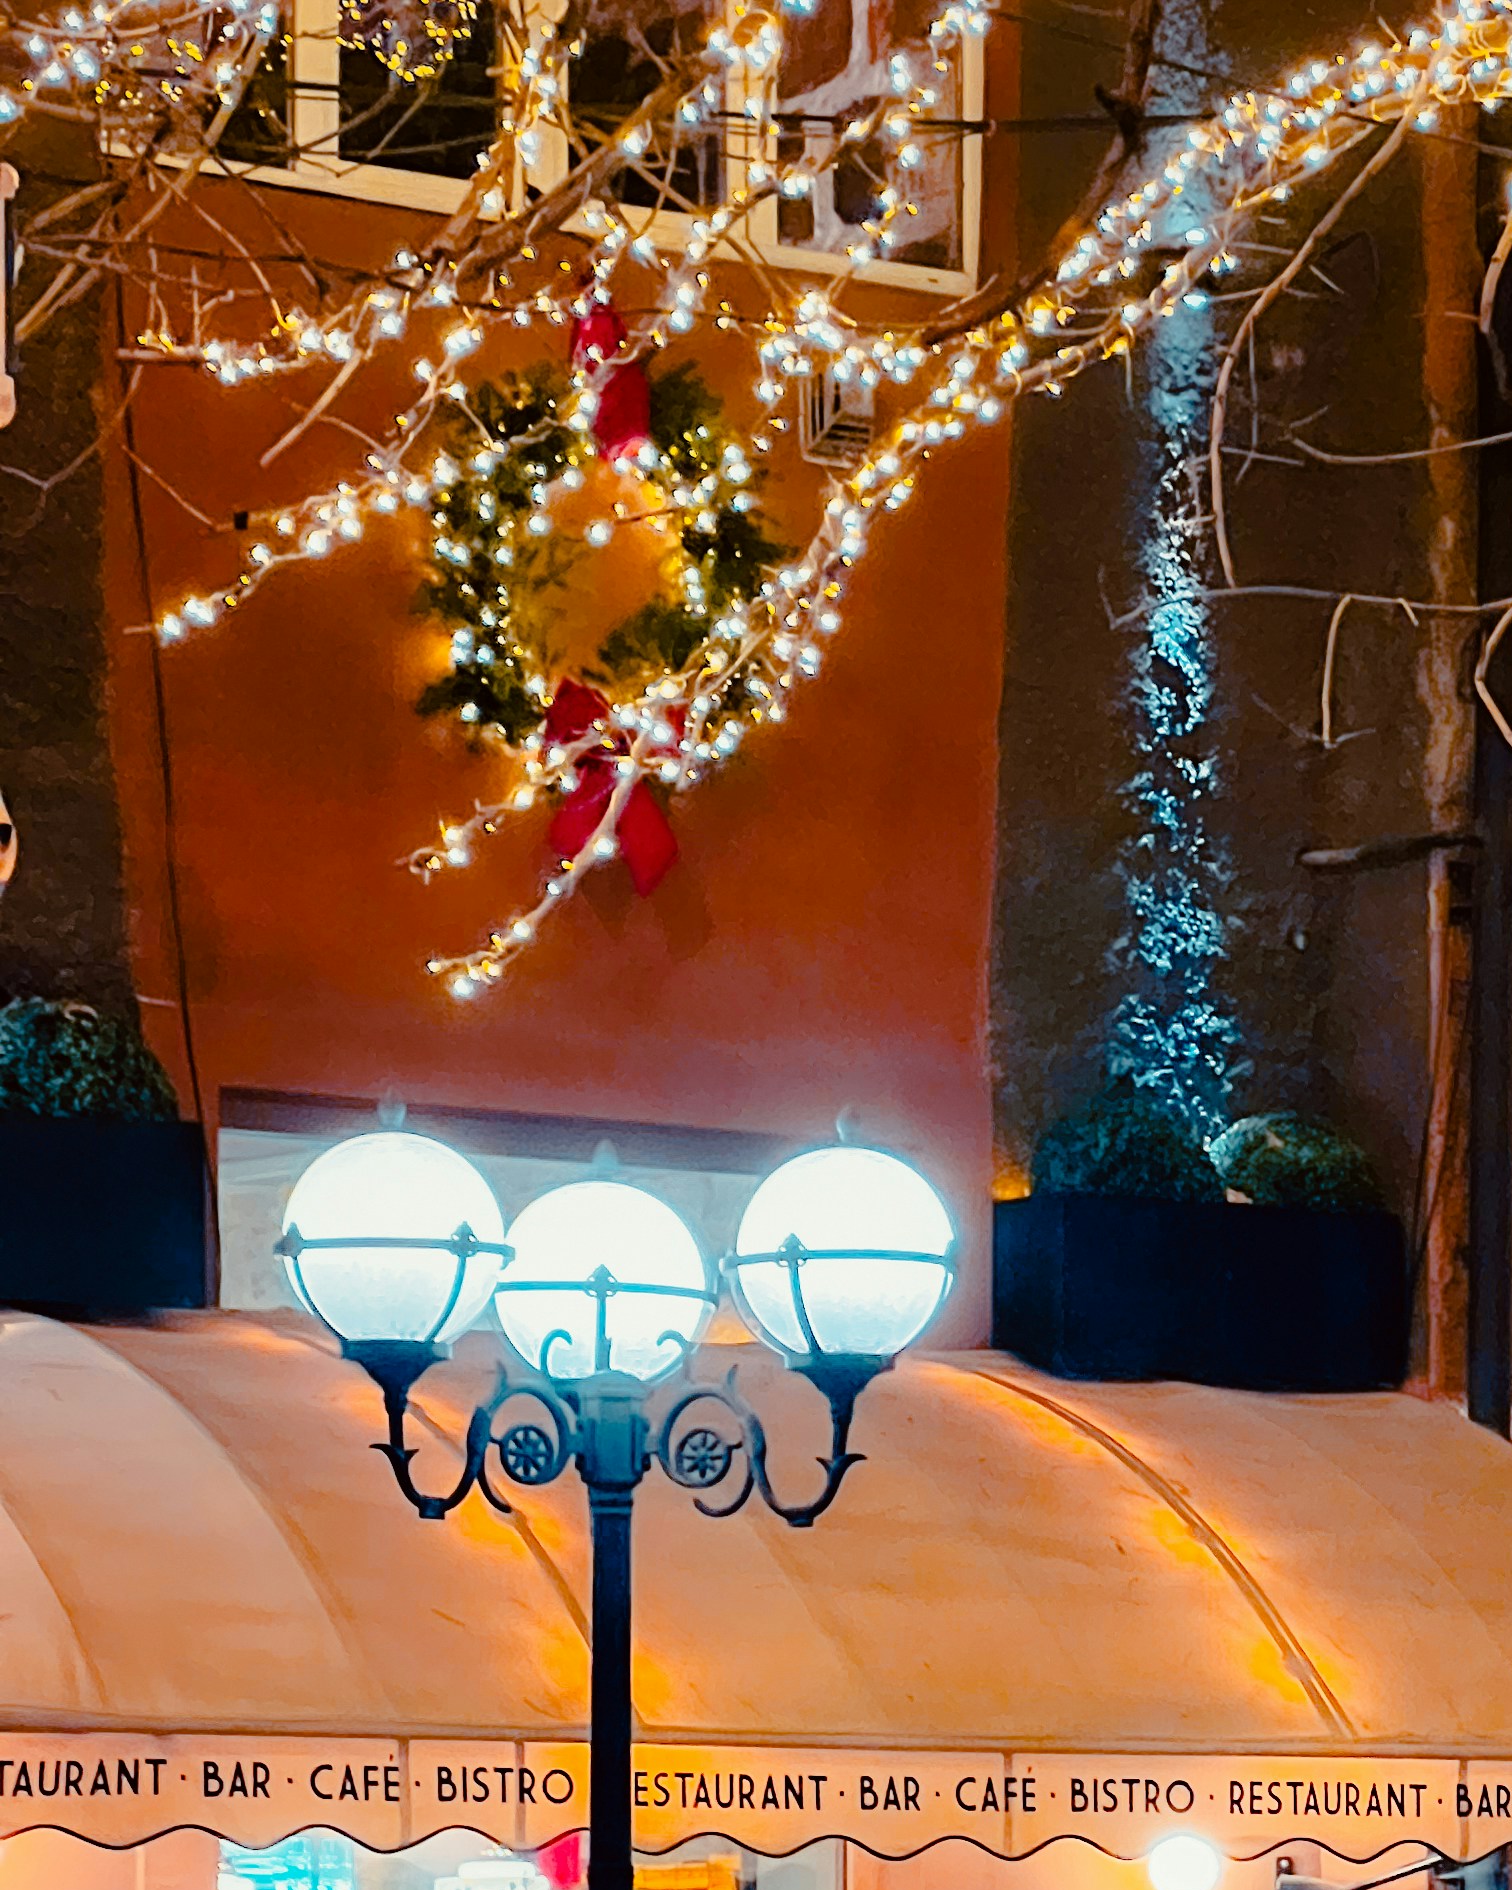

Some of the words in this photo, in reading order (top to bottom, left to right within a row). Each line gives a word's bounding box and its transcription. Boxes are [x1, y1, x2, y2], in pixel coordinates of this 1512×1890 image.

[203, 1760, 271, 1799] BAR
[309, 1753, 400, 1802] CAFÉ
[437, 1766, 574, 1804] BISTRO
[634, 1771, 828, 1811] ESTAURANT
[860, 1775, 921, 1812] BAR
[955, 1766, 1037, 1813] CAFÉ
[1070, 1778, 1195, 1813] BISTRO
[1229, 1780, 1428, 1818] RESTAURANT
[1456, 1783, 1511, 1818] BAR
